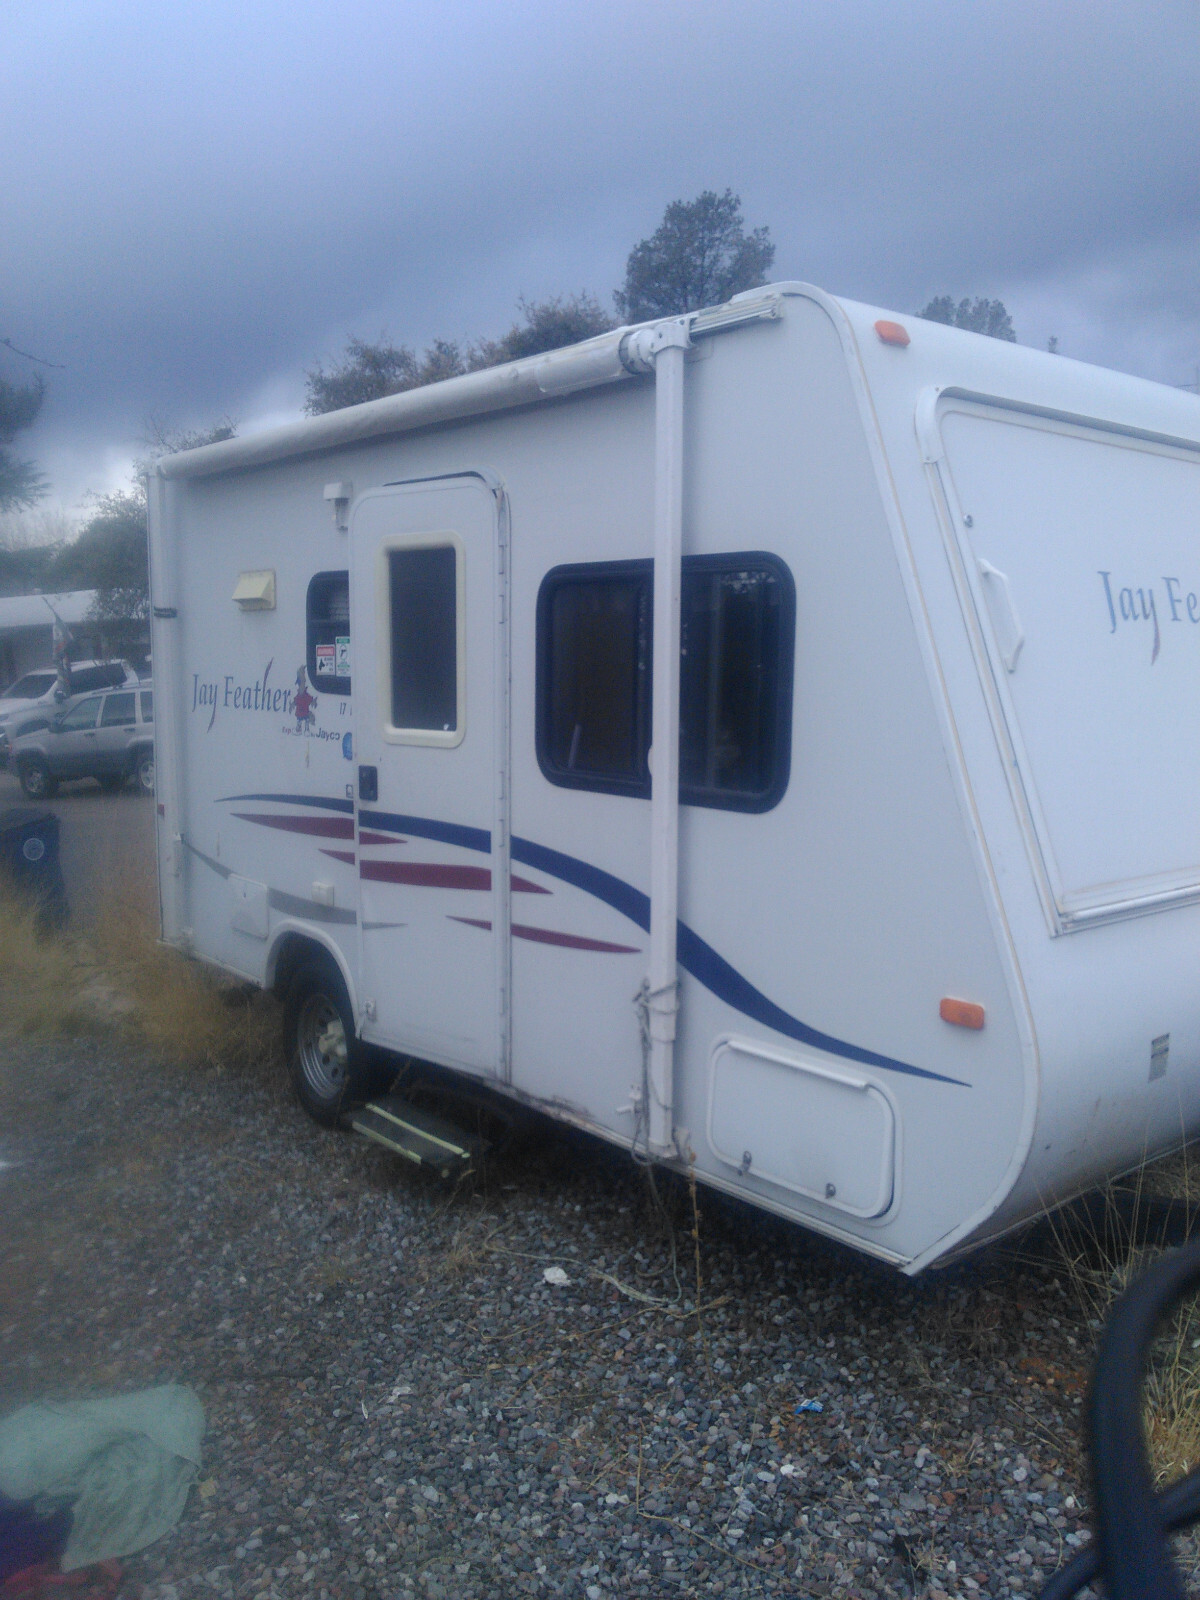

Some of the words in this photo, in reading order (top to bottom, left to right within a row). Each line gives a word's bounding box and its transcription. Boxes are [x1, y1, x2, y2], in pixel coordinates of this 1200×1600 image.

[1096, 570, 1161, 666] Jay
[192, 674, 218, 734] Jay
[223, 656, 291, 713] Feather
